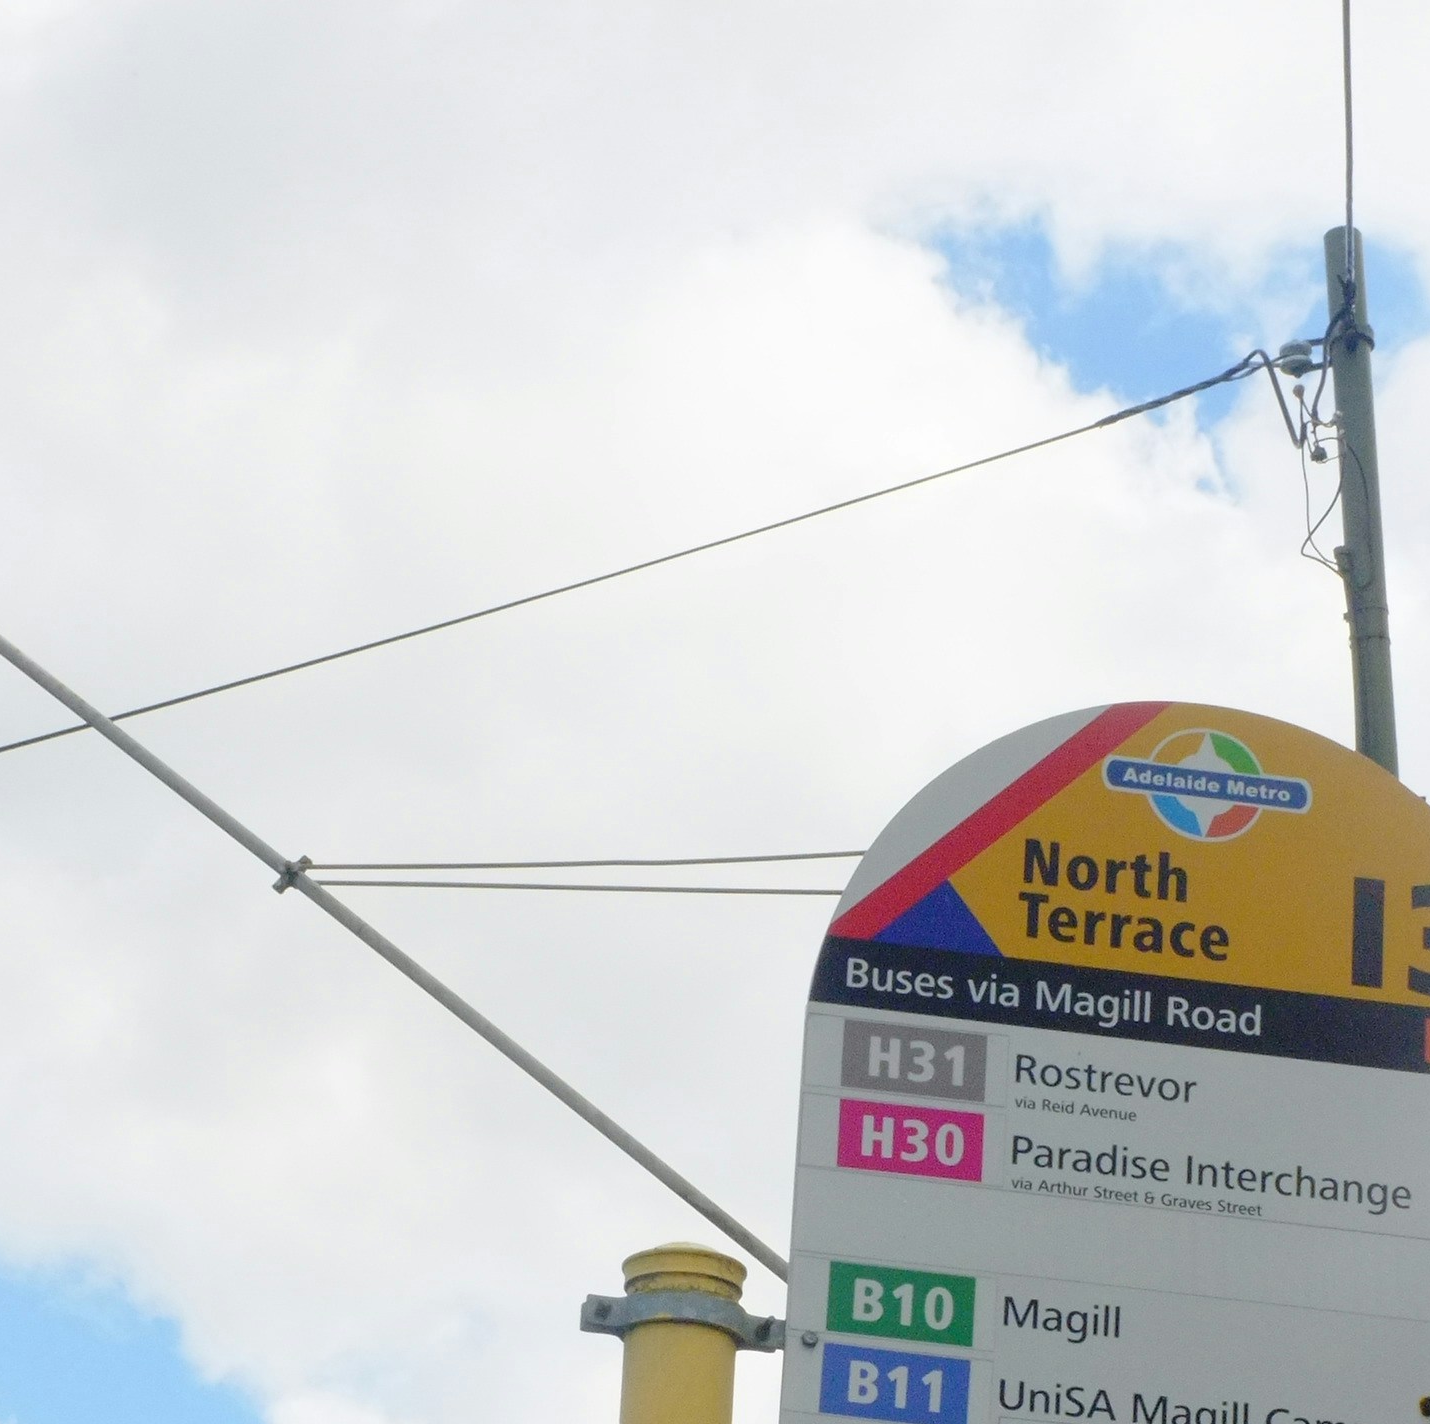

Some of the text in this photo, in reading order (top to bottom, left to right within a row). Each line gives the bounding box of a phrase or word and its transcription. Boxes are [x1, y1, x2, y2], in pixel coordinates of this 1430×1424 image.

[1123, 767, 1291, 802] Adelaide Metro
[1022, 837, 1189, 904] North
[1018, 891, 1231, 962] Terrace
[845, 957, 1263, 1037] Buses via Magill Road
[867, 1035, 968, 1088] H31
[1015, 1053, 1198, 1104] Rostrevor
[1015, 1097, 1138, 1122] via Reid Avenue
[859, 1114, 966, 1168] H30
[1011, 1135, 1412, 1216] Paradise Interchange
[1011, 1176, 1264, 1217] via Arthur Street & Graves Street
[852, 1277, 955, 1330] B10
[1002, 1295, 1122, 1344] Magill
[846, 1359, 945, 1414] B11
[998, 1378, 1117, 1422] UniSA
